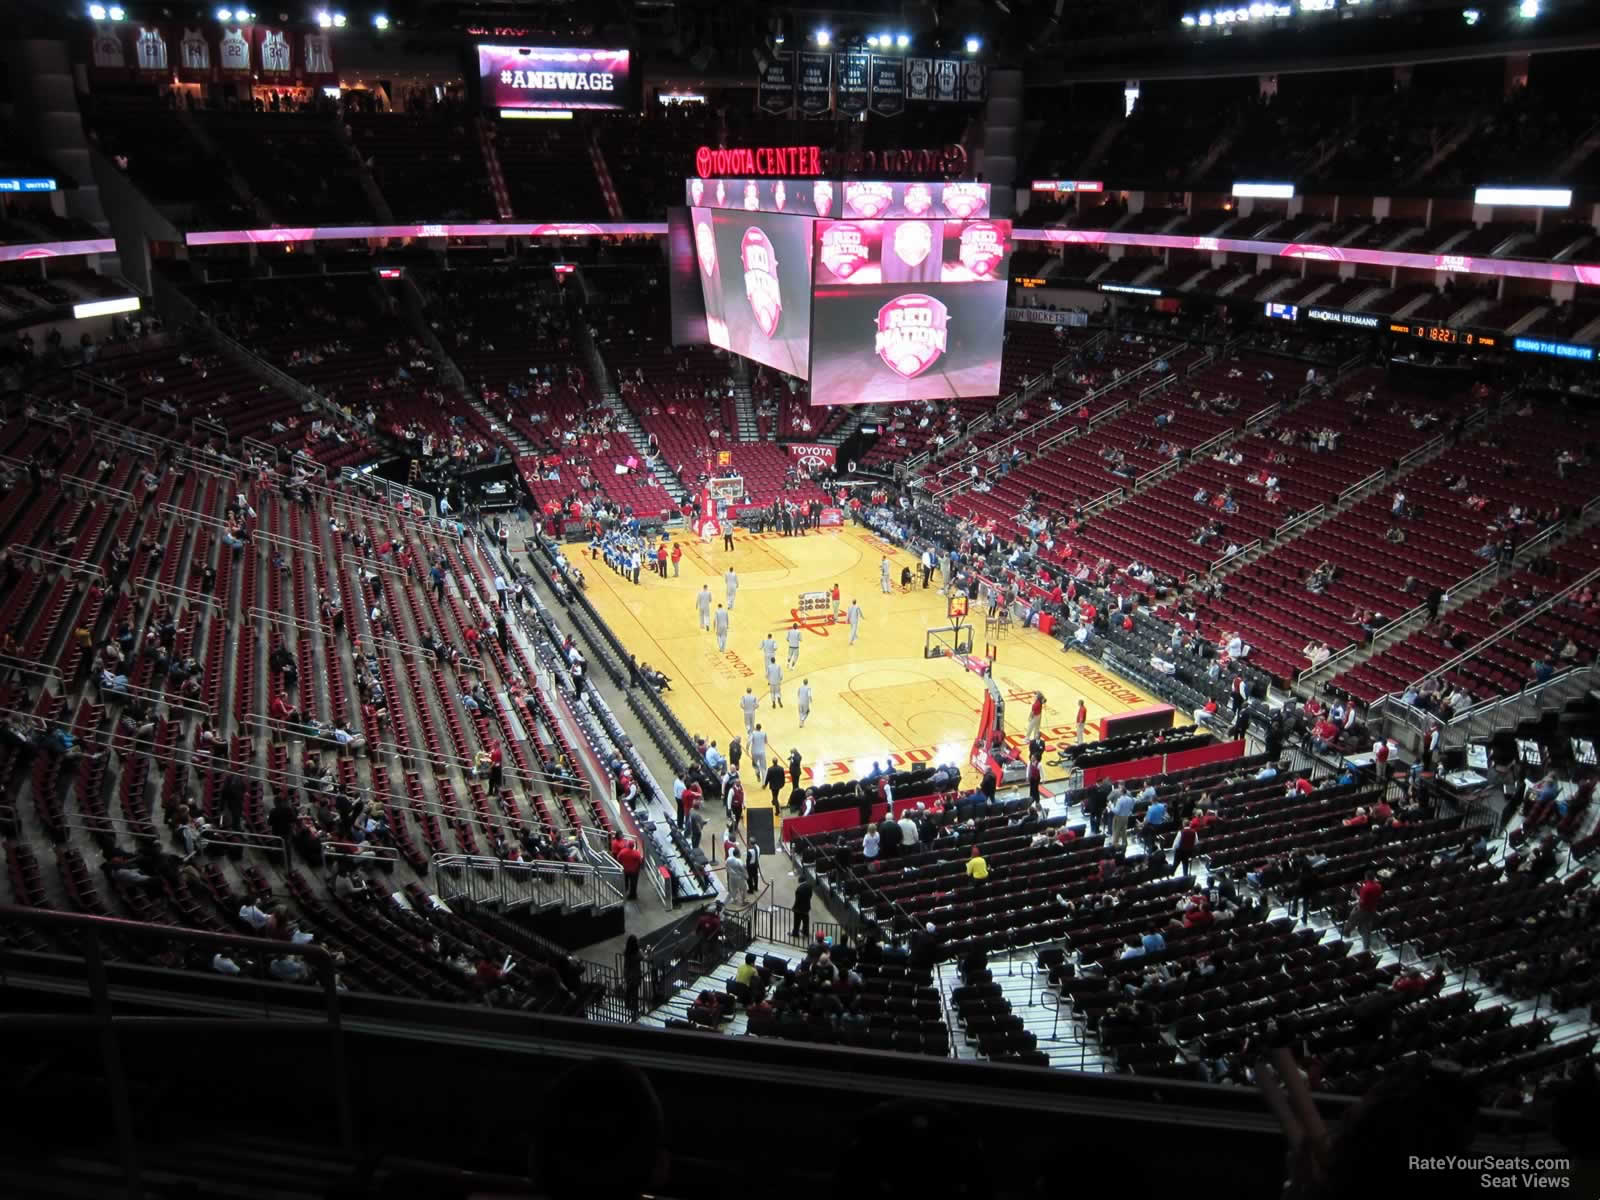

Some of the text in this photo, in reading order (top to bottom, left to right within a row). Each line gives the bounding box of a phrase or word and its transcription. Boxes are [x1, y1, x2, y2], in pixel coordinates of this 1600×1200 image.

[500, 70, 614, 91] #ANEWAGE
[711, 146, 820, 175] TOYOTA CENTER
[1308, 310, 1341, 322] MEMORIAL
[1342, 314, 1378, 327] HERMANN
[1540, 343, 1556, 352] THE
[791, 446, 833, 457] TOYOTA
[1072, 665, 1145, 704] ROCKETS.COM
